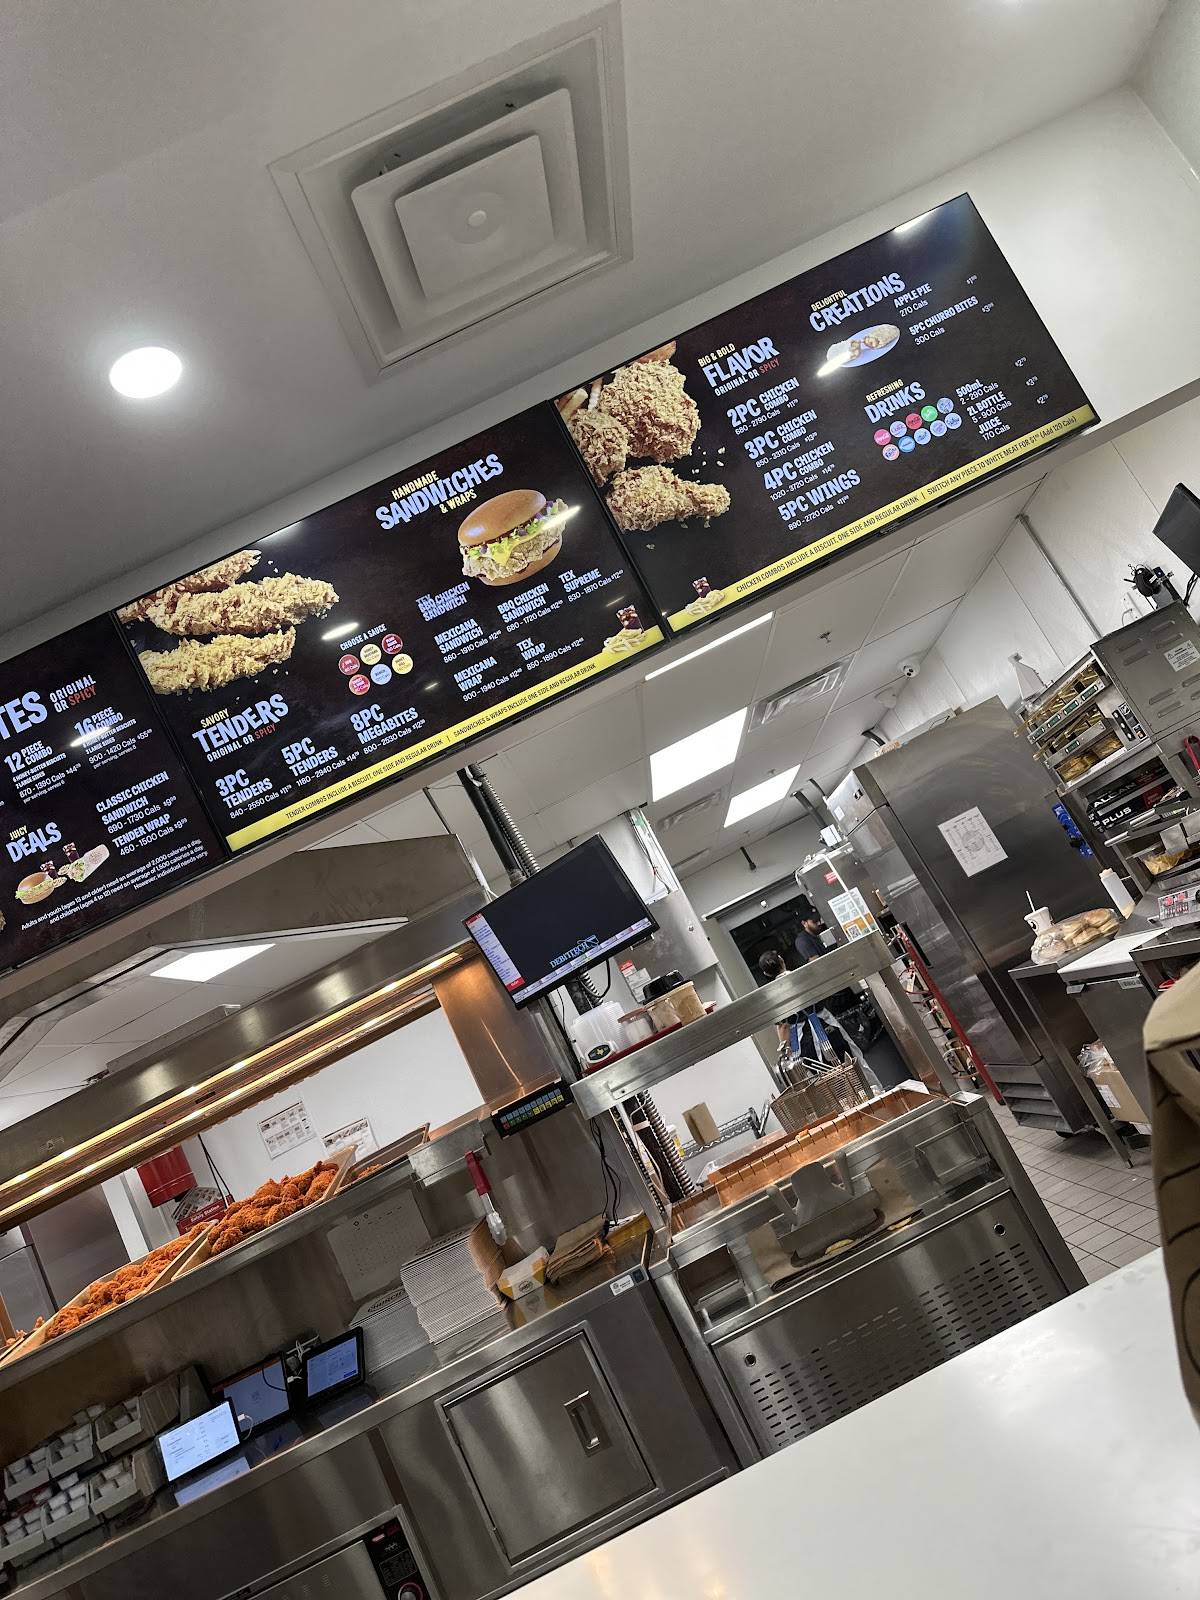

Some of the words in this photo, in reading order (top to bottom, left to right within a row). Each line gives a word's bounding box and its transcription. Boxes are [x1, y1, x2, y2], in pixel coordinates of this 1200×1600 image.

[810, 289, 847, 311] DELIGHTFUL
[810, 273, 904, 331] CREATIONS
[893, 289, 919, 308] APPLE
[916, 282, 932, 296] PIE
[899, 305, 913, 317] 270
[912, 299, 928, 310] Cals
[908, 321, 926, 335] 5PC
[924, 307, 956, 327] CHURRO
[953, 295, 978, 313] BITES
[914, 333, 930, 345] 300
[929, 327, 945, 337] Cals
[697, 355, 711, 367] BIG
[709, 352, 718, 361] &
[716, 343, 735, 357] BOLD
[703, 337, 778, 387] FLAVOR
[714, 375, 748, 396] ORIGINAL
[746, 368, 760, 379] OR
[758, 357, 779, 373] SPICY
[955, 379, 983, 397] 500mL
[982, 382, 999, 393] Cals
[759, 377, 799, 403] CHICKEN
[764, 393, 789, 411] COMBO
[864, 382, 925, 422] DRINKS
[865, 379, 903, 402] REFRESHING
[726, 398, 761, 427] 2PC
[966, 405, 978, 416] 2L
[975, 391, 1006, 411] BOTTLE
[980, 406, 996, 418] 900
[995, 400, 1012, 411] Cals
[734, 424, 748, 435] 680
[750, 414, 767, 427] 2790
[766, 409, 780, 419] Cals
[776, 409, 817, 436] CHICKEN
[781, 426, 806, 443] COMBO
[978, 416, 1002, 434] JUICE
[982, 430, 995, 441] 170
[994, 424, 1010, 435] Cals
[744, 430, 779, 459] 3PC
[755, 456, 769, 468] 850
[771, 447, 787, 459] 3310
[786, 442, 800, 452] Cals
[793, 441, 834, 468] CHICKEN
[763, 462, 797, 489] 4PC
[798, 458, 824, 475] COMBO
[376, 454, 502, 528] SANDWICHES
[391, 470, 438, 499] HANDMADE
[769, 489, 786, 501] 1020
[788, 479, 804, 491] 3720
[803, 473, 818, 483] Cals
[778, 495, 808, 520] 5PC
[806, 469, 860, 505] WINGS
[439, 503, 448, 513] &
[447, 488, 477, 509] WRAPS
[787, 519, 802, 530] 890
[804, 509, 820, 522] 2720
[819, 504, 834, 514] Cals
[736, 575, 762, 593] CHICKEN
[760, 563, 786, 580] COMBOS
[784, 551, 810, 568] INCLUDE
[837, 530, 850, 541] ONE
[848, 523, 864, 535] SIDE
[863, 517, 876, 528] AND
[874, 504, 901, 522] REGULAR
[899, 495, 919, 509] DRINK
[558, 569, 576, 583] TEX
[563, 568, 601, 592] SUPREME
[434, 581, 470, 605] CHICKEN
[497, 599, 516, 614] BBQ
[513, 583, 549, 606] CHICKEN
[567, 591, 581, 602] 830
[583, 582, 598, 594] 1870
[597, 577, 612, 587] Cals
[423, 594, 466, 621] SANDWICH
[502, 595, 546, 622] SANDWICH
[506, 621, 520, 632] 680
[522, 612, 537, 624] 1720
[536, 607, 551, 617] Cals
[339, 634, 363, 650] CHOOSE
[362, 632, 369, 640] A
[367, 623, 387, 637] SAUCE
[434, 618, 478, 645] MEXICANA
[439, 626, 483, 653] SANDWICH
[516, 637, 534, 651] TEX
[443, 652, 457, 663] 860
[460, 643, 475, 654] 1910
[474, 638, 488, 648] Cals
[521, 642, 545, 660] WRAP
[526, 659, 539, 670] 850
[542, 650, 558, 662] 1890
[557, 645, 571, 654] Cals
[453, 656, 497, 682] MEXICANA
[458, 673, 482, 691] WRAP
[49, 674, 96, 702] ORIGINAL
[53, 699, 69, 712] OR
[68, 685, 96, 705] SPICY
[462, 690, 477, 701] 900
[479, 681, 496, 693] 1940
[495, 675, 509, 685] Cals
[74, 717, 95, 737] 16
[91, 706, 114, 723] PIECE
[95, 712, 123, 732] COMBO
[193, 694, 288, 756] TENDERS
[200, 708, 229, 728] SAVORY
[350, 704, 384, 731] 8PC
[357, 707, 418, 743] MEGABITES
[20, 740, 44, 757] PIECE
[88, 752, 103, 764] 900
[106, 743, 122, 755] 1420
[121, 737, 136, 748] Cals
[206, 740, 242, 762] ORIGINAL
[242, 734, 255, 745] OR
[254, 723, 275, 739] SPICY
[281, 737, 315, 764] 5PC
[363, 743, 377, 754] 800
[380, 733, 398, 745] 2530
[397, 727, 412, 737] Cals
[4, 751, 25, 773] 12
[24, 746, 52, 765] COMBO
[289, 746, 338, 776] TENDERS
[19, 787, 32, 798] 870
[50, 772, 65, 782] Cals
[215, 768, 249, 796] 3PC
[295, 775, 311, 786] 1180
[314, 765, 332, 778] 2940
[331, 759, 346, 769] Cals
[95, 789, 132, 812] CLASSIC
[131, 771, 169, 795] CHICKEN
[223, 778, 272, 808] TENDERS
[101, 796, 148, 824] SANDWICH
[229, 807, 244, 819] 840
[247, 797, 265, 810] 2550
[264, 791, 279, 802] Cals
[1102, 806, 1132, 826] PLUS
[107, 821, 123, 833] 690
[126, 810, 144, 824] 1730
[144, 804, 161, 815] Cals
[112, 826, 146, 847] TENDER
[143, 813, 170, 832] WRAP
[6, 822, 61, 862] DEALS
[9, 825, 27, 840] JUICY
[120, 843, 135, 855] 460
[138, 832, 157, 846] 1500
[157, 826, 174, 837] Cals
